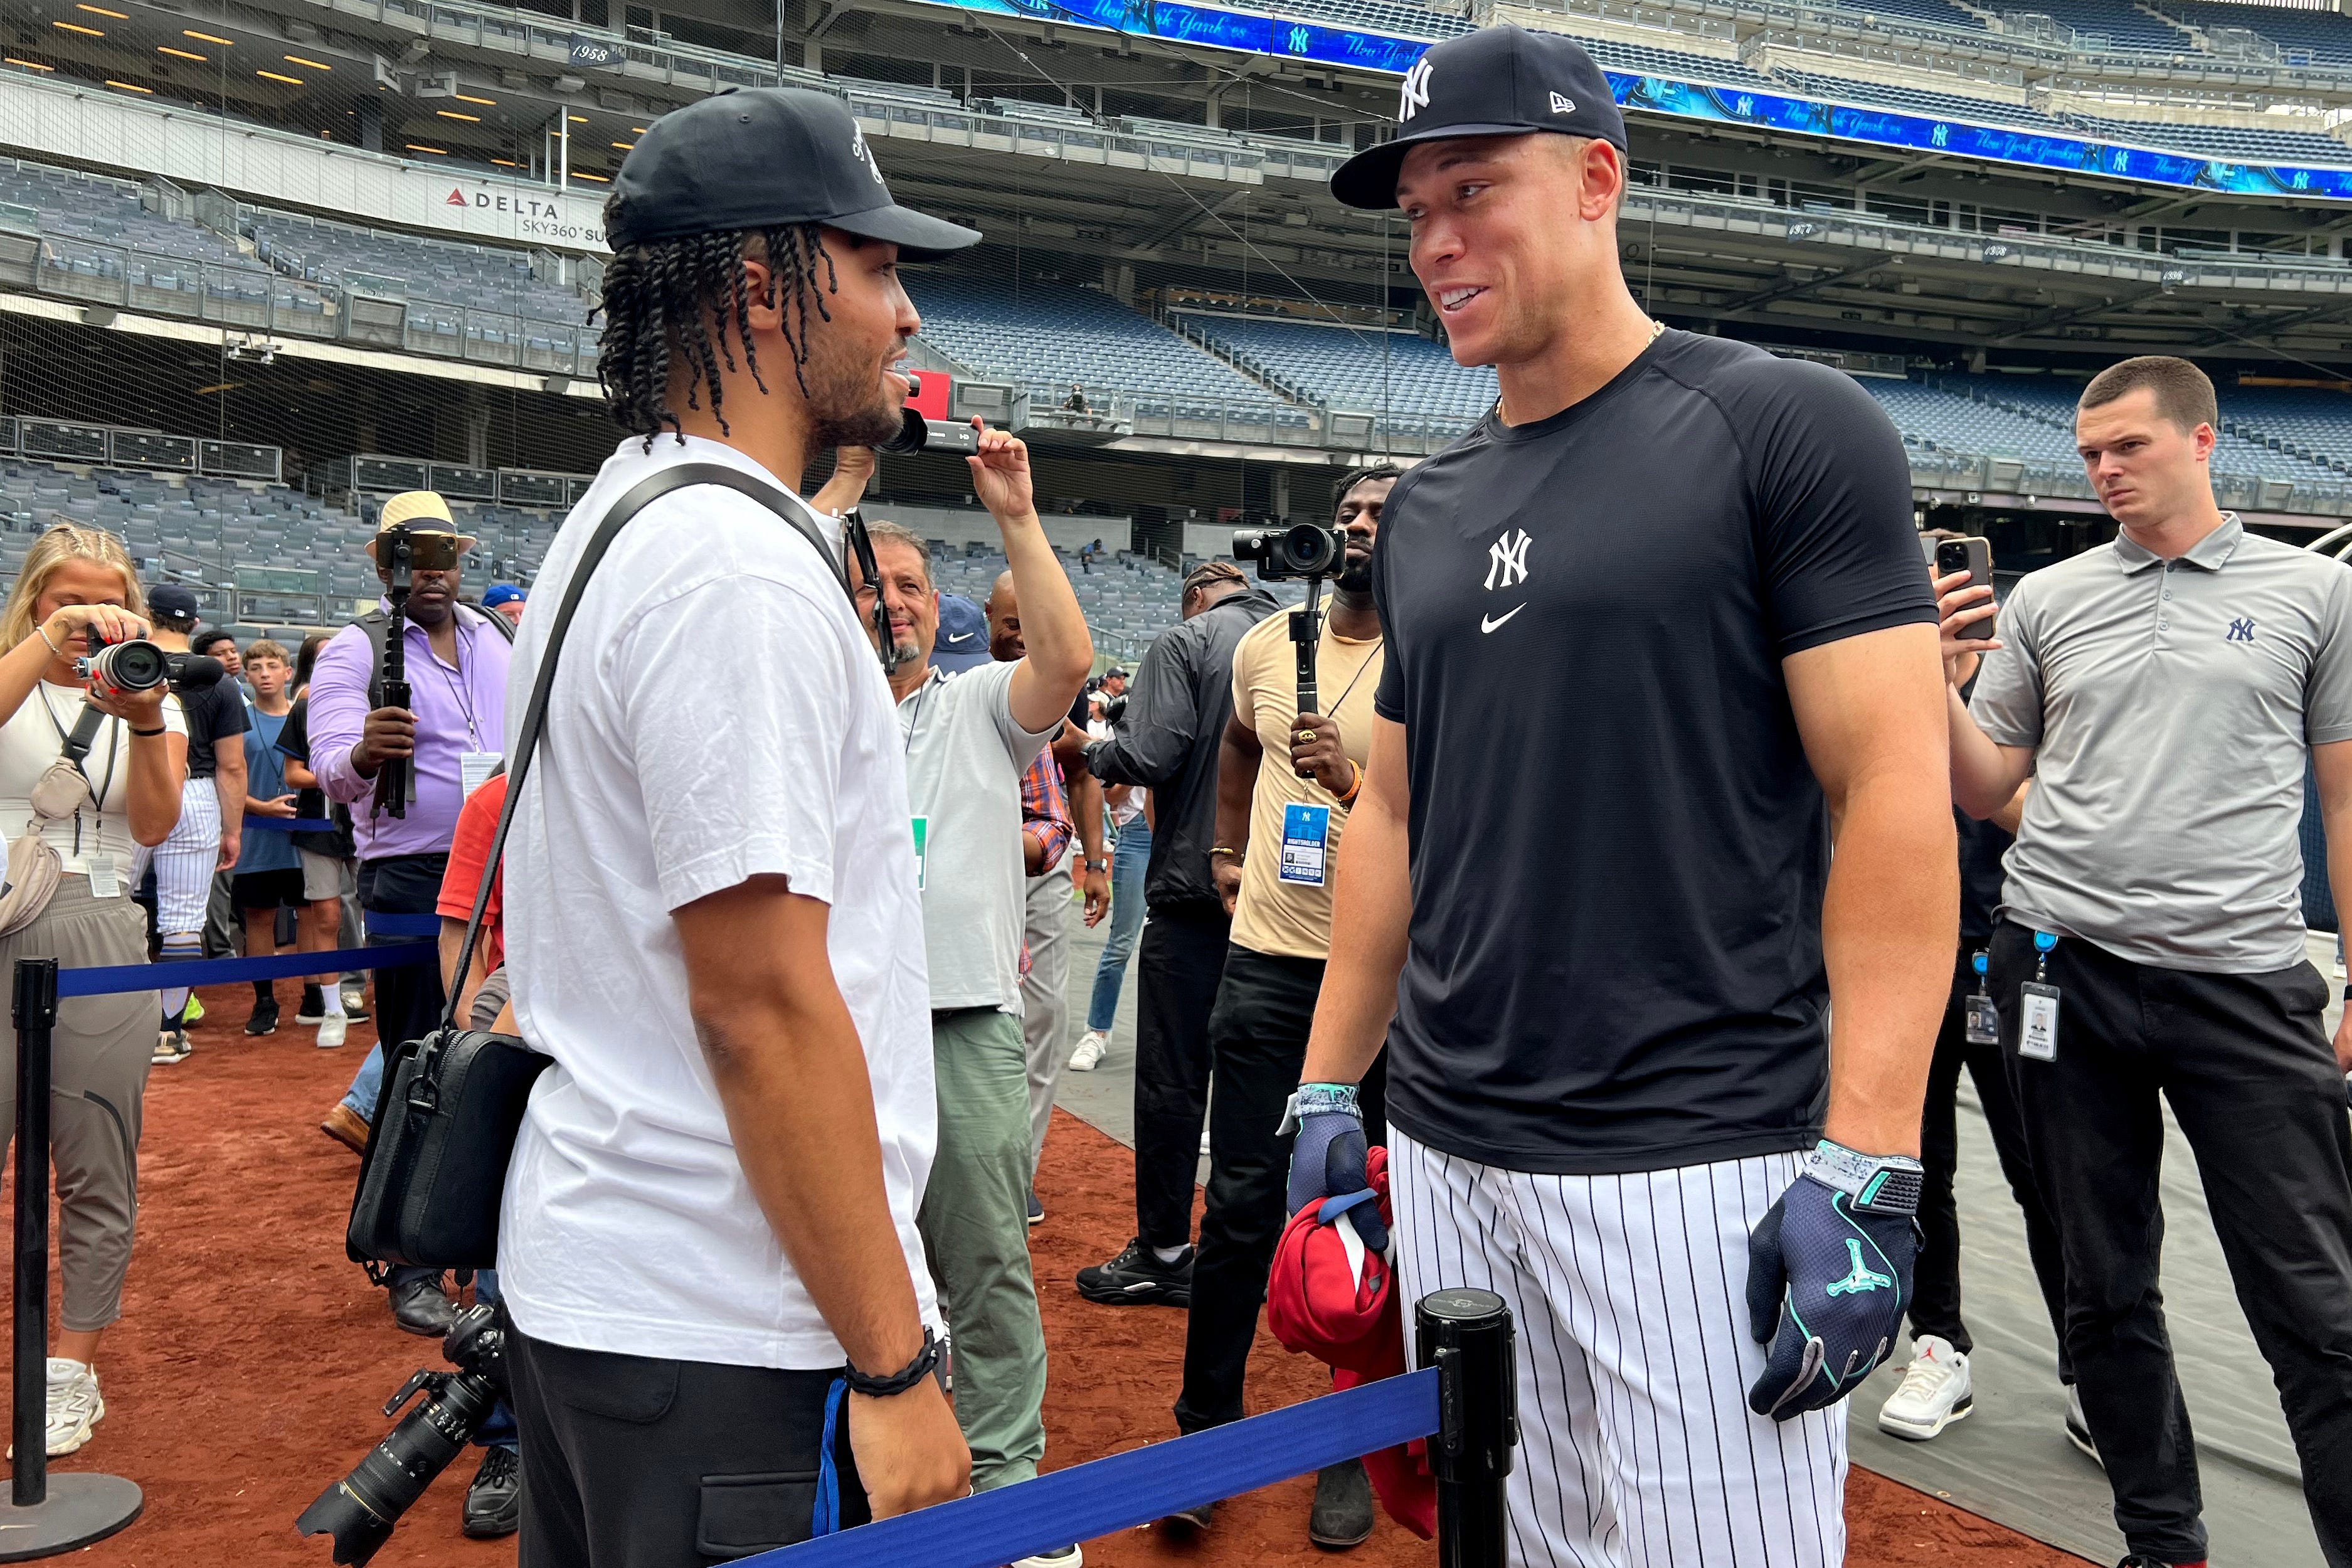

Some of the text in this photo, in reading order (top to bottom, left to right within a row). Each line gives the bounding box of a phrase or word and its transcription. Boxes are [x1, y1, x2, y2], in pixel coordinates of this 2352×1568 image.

[1175, 9, 1247, 39] Yankes
[572, 45, 608, 61] 1958
[1288, 26, 1308, 53] NY
[1345, 34, 1377, 58] New
[1399, 57, 1434, 124] NY
[476, 193, 558, 220] DELTA
[1789, 224, 1813, 235] 1977
[1483, 528, 1533, 591] NY
[2227, 617, 2256, 642] NY
